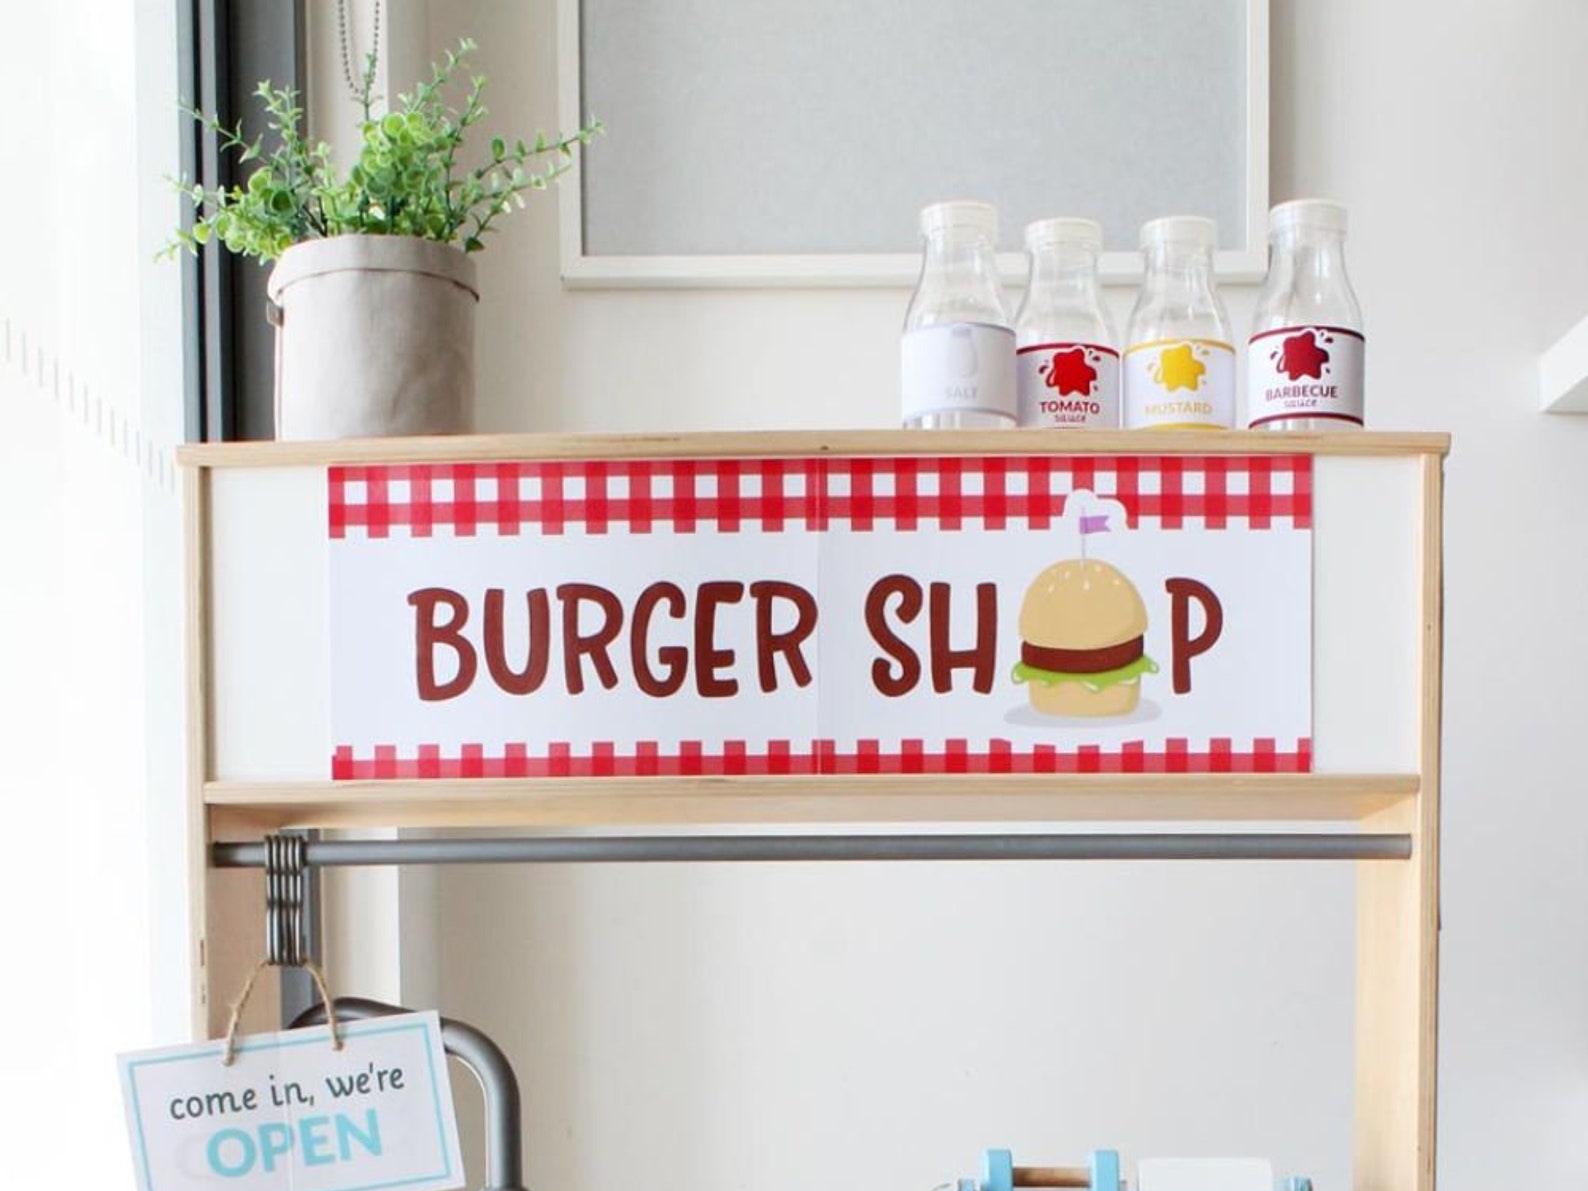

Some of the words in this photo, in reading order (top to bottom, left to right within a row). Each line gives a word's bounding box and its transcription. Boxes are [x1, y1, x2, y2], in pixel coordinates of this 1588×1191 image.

[945, 386, 979, 399] SALT
[1264, 385, 1338, 401] BARBECUE
[1039, 400, 1100, 415] TOMATO
[1144, 402, 1213, 416] MUSTARD
[1283, 398, 1318, 408] sauce
[1054, 413, 1086, 423] sauce
[406, 580, 819, 701] BURGER
[865, 573, 1224, 698] SHP
[170, 1088, 257, 1120] come
[268, 1075, 315, 1107] in,
[325, 1063, 405, 1097] we're
[205, 1107, 383, 1178] OPEN
